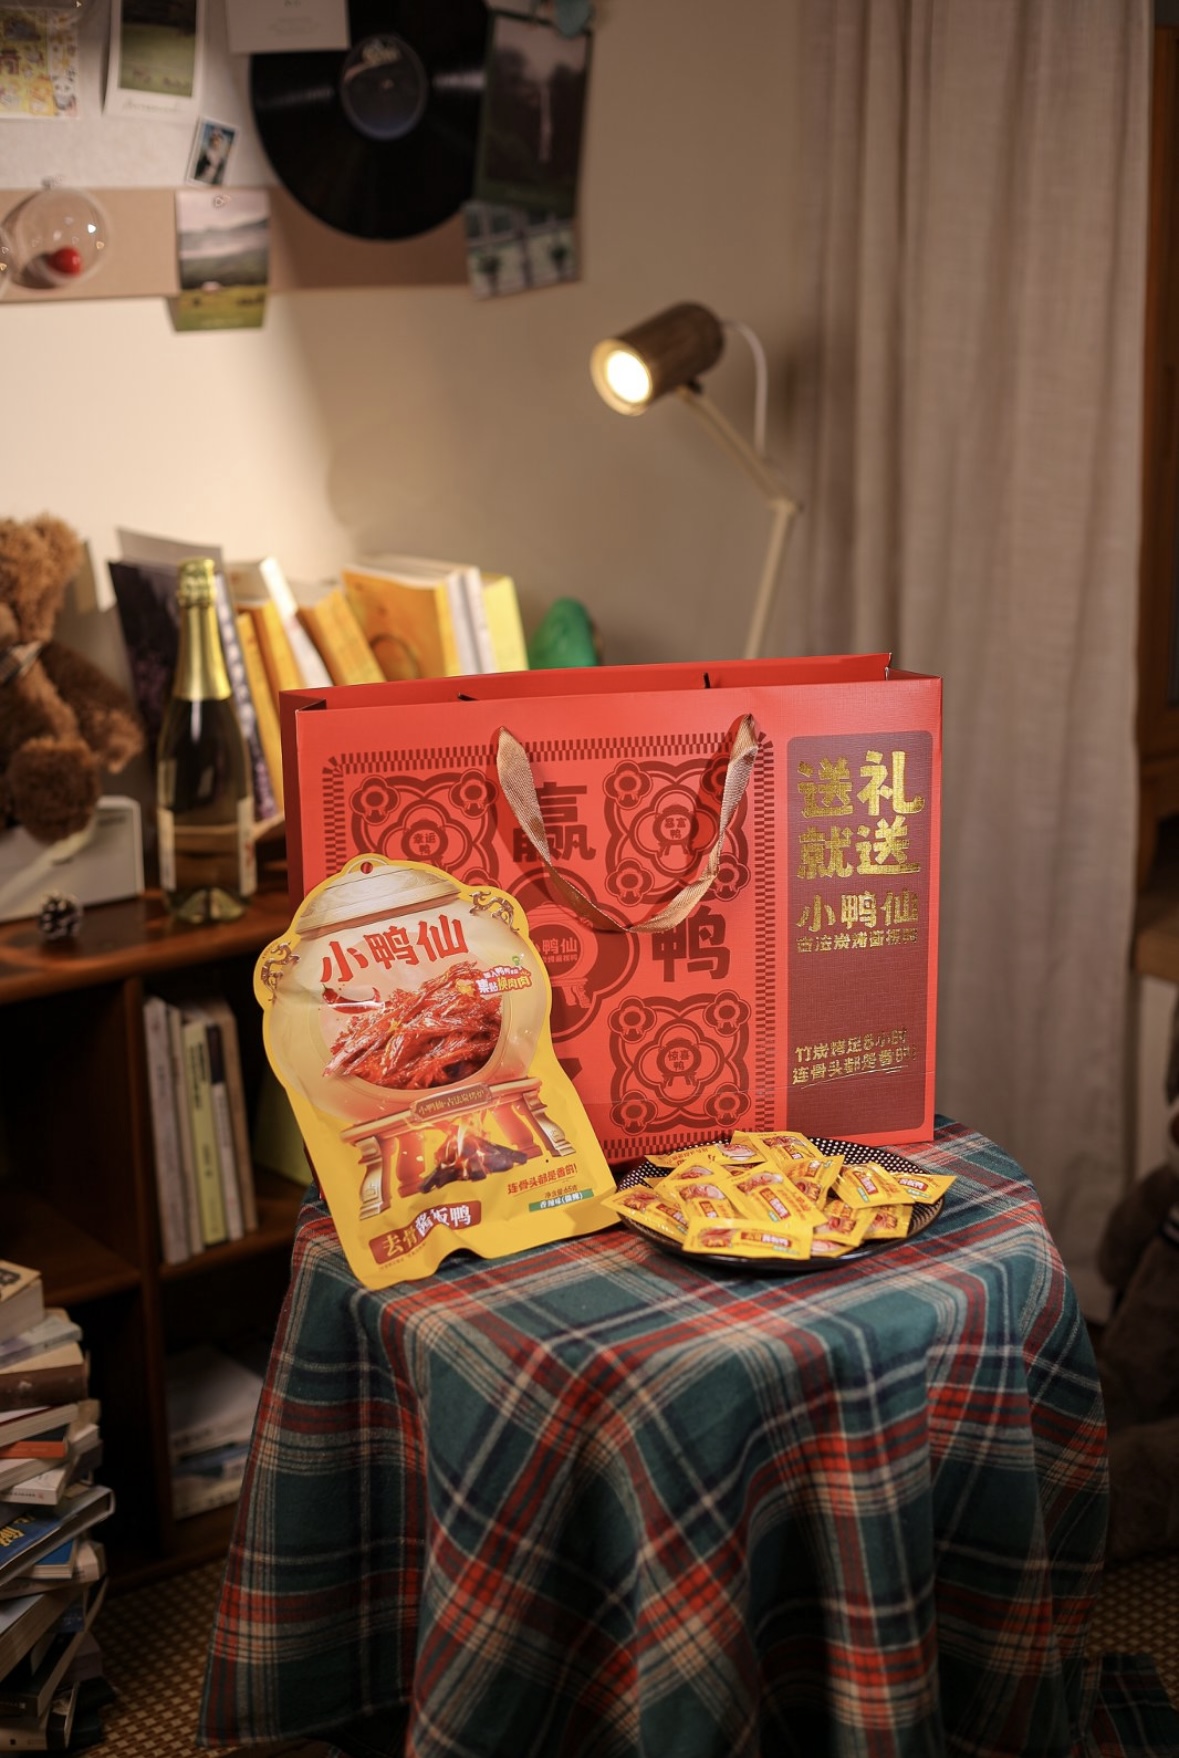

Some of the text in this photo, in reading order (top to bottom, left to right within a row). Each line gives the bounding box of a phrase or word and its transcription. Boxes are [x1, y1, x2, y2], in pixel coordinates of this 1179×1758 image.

[797, 750, 925, 819] 送礼
[797, 815, 921, 880] 就送
[652, 905, 731, 983] 鸭
[796, 891, 918, 932] 小鸭仙
[320, 914, 469, 983] 小鸭仙
